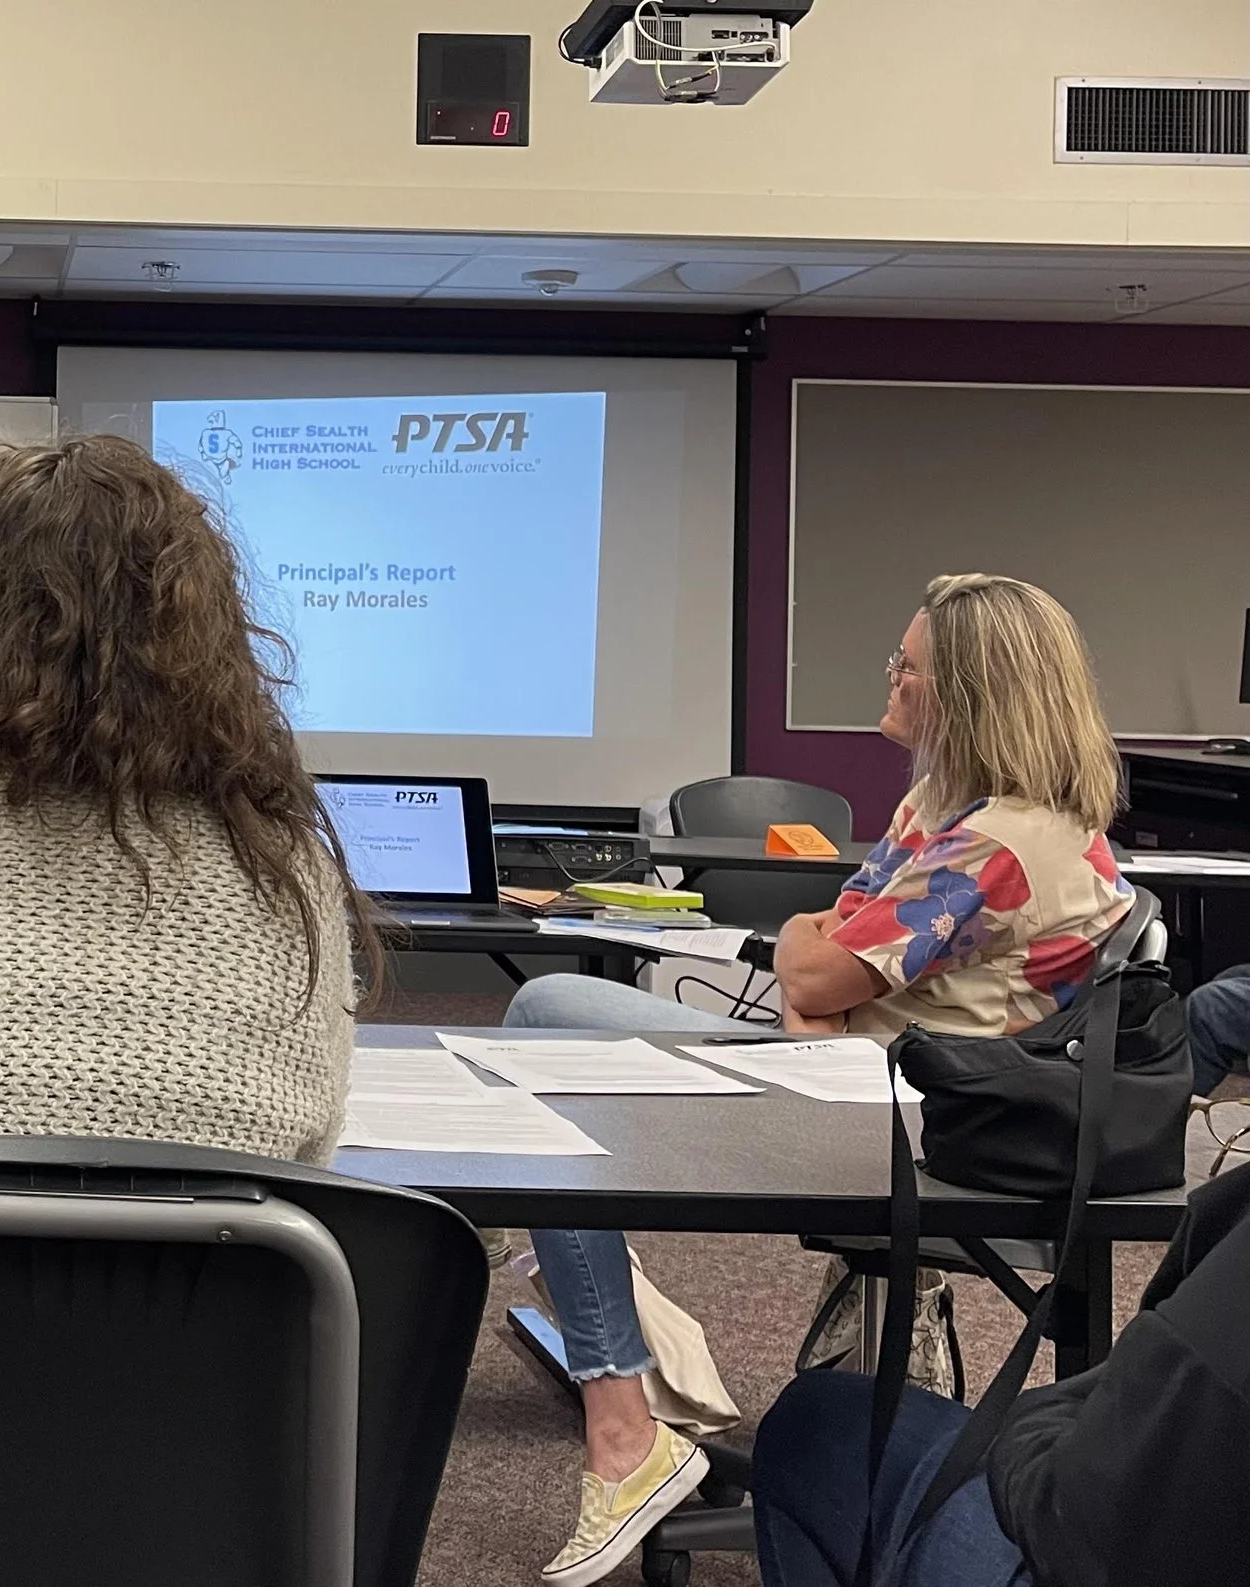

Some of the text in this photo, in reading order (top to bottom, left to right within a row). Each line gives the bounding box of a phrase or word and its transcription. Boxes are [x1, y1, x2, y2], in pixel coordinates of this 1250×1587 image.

[493, 112, 510, 136] 0
[251, 424, 369, 439] CHIEF SEALTH
[391, 412, 529, 453] PTSA
[252, 441, 379, 454] INTERNATIONAL
[252, 457, 361, 470] HIGH SCHOOL
[278, 563, 457, 585] Principal's Report
[303, 590, 429, 612] Ray Morales
[395, 791, 439, 804] PTSA
